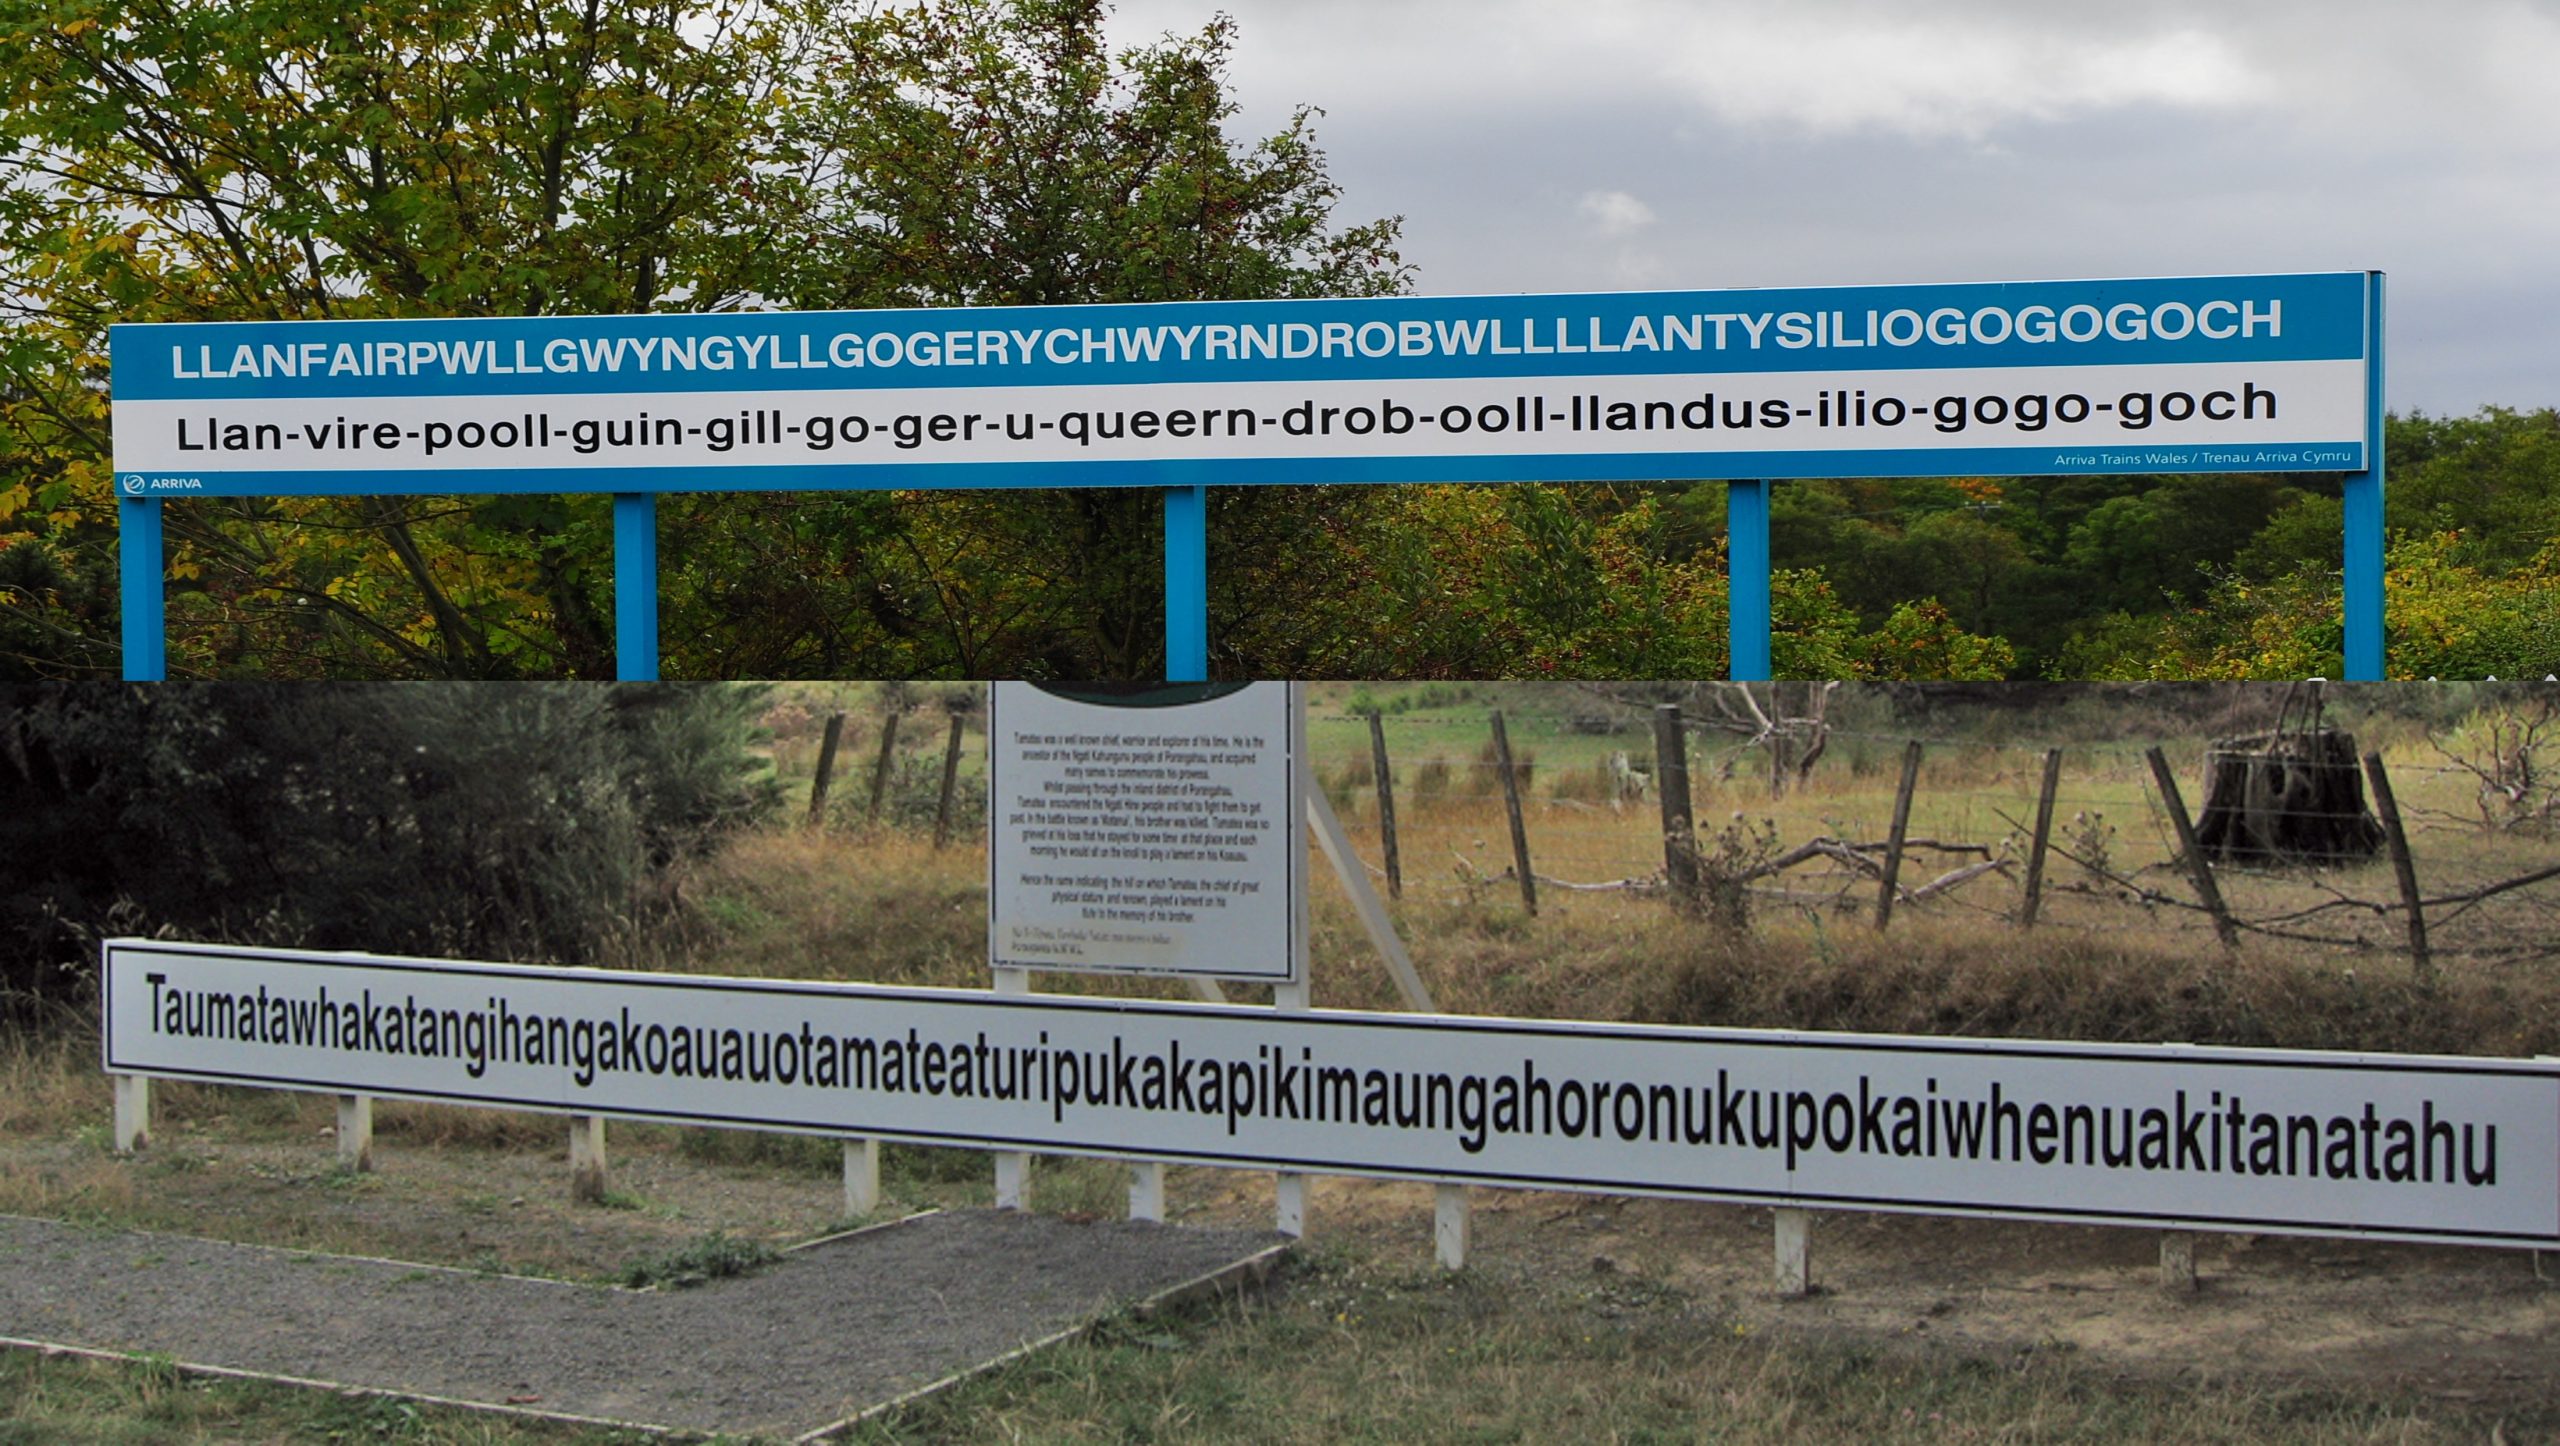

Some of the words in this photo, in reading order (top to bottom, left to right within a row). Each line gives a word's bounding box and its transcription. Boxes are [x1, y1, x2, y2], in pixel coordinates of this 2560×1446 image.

[172, 299, 2281, 379] LLANFAIRPWLLGWYNGYLLGOGERYCHWYRNDROBWLLLLANTYSILIOGOGOGOCH
[178, 382, 2276, 456] Llan-vire-pooll-guin-gill-go-ger-u-queern-drob-ooll-llandus-ilio-gogo-goch
[150, 478, 203, 489] ARRIVA
[2054, 454, 2096, 465] Arriva
[2101, 453, 2141, 465] Trains
[2145, 453, 2188, 465] Wales
[2191, 452, 2198, 464] /
[2202, 452, 2250, 463] Trenau
[2254, 451, 2298, 463] Arriva
[2302, 450, 2351, 465] Cymru
[146, 973, 2497, 1187] Taumatawhakatangihangakoauauotamateaturipukakapikimaungahoronukupokaiwhenuakitanatahu
